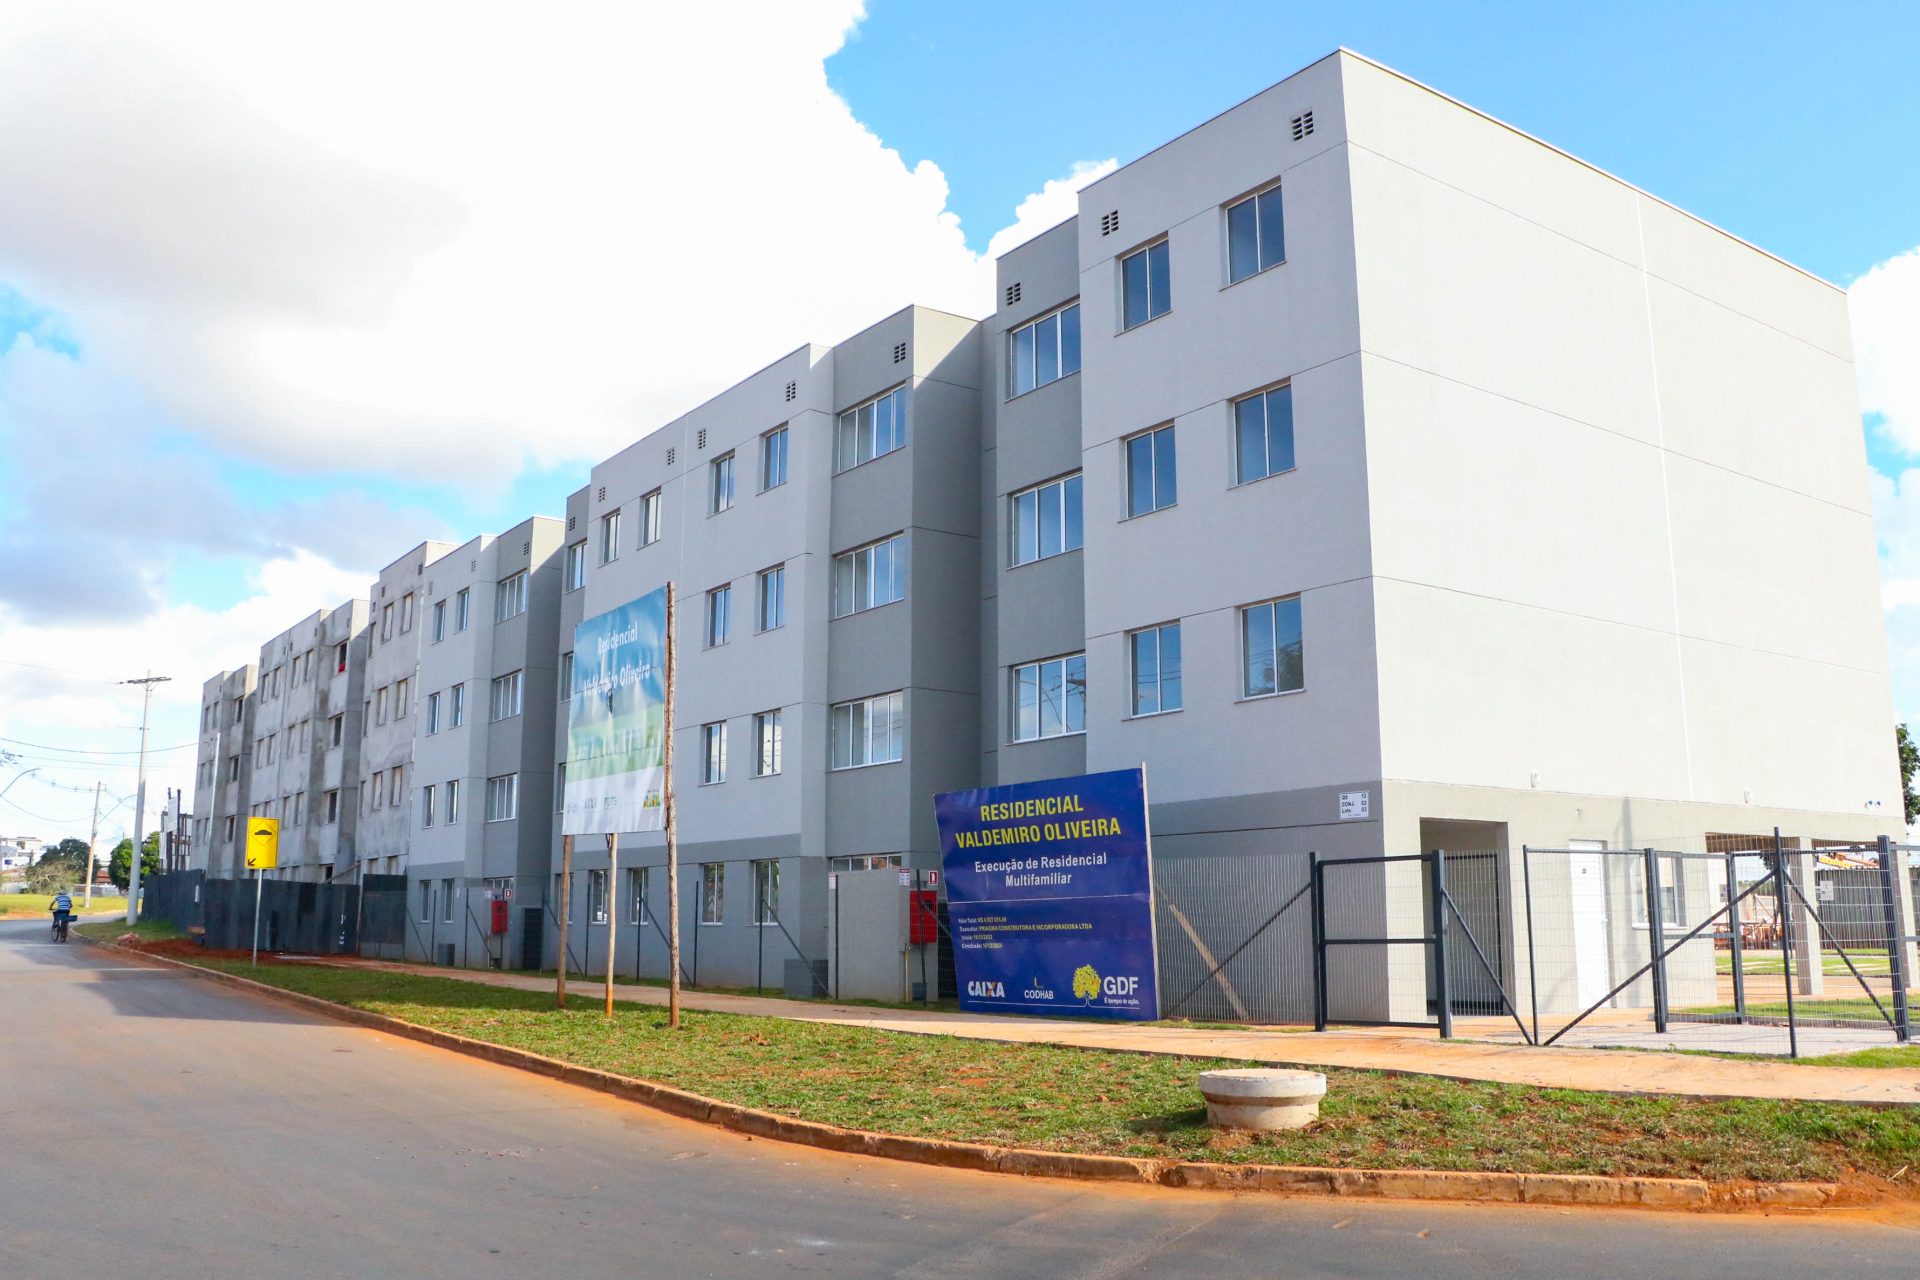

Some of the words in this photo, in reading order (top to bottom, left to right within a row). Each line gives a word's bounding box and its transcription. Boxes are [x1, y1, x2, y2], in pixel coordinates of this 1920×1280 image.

[598, 621, 638, 655] Residencial
[980, 795, 1084, 821] RESIDENCIAL
[955, 824, 1041, 849] VALDEMIRO
[1044, 817, 1121, 841] OLIVEIRA
[975, 858, 1024, 874] Execução
[1025, 856, 1039, 869] de
[1041, 852, 1107, 868] Residencial
[1005, 872, 1072, 887] Multifamiliar
[967, 980, 1005, 998] CAIXA
[1024, 989, 1054, 999] CODHAB
[1103, 976, 1139, 995] GDF
